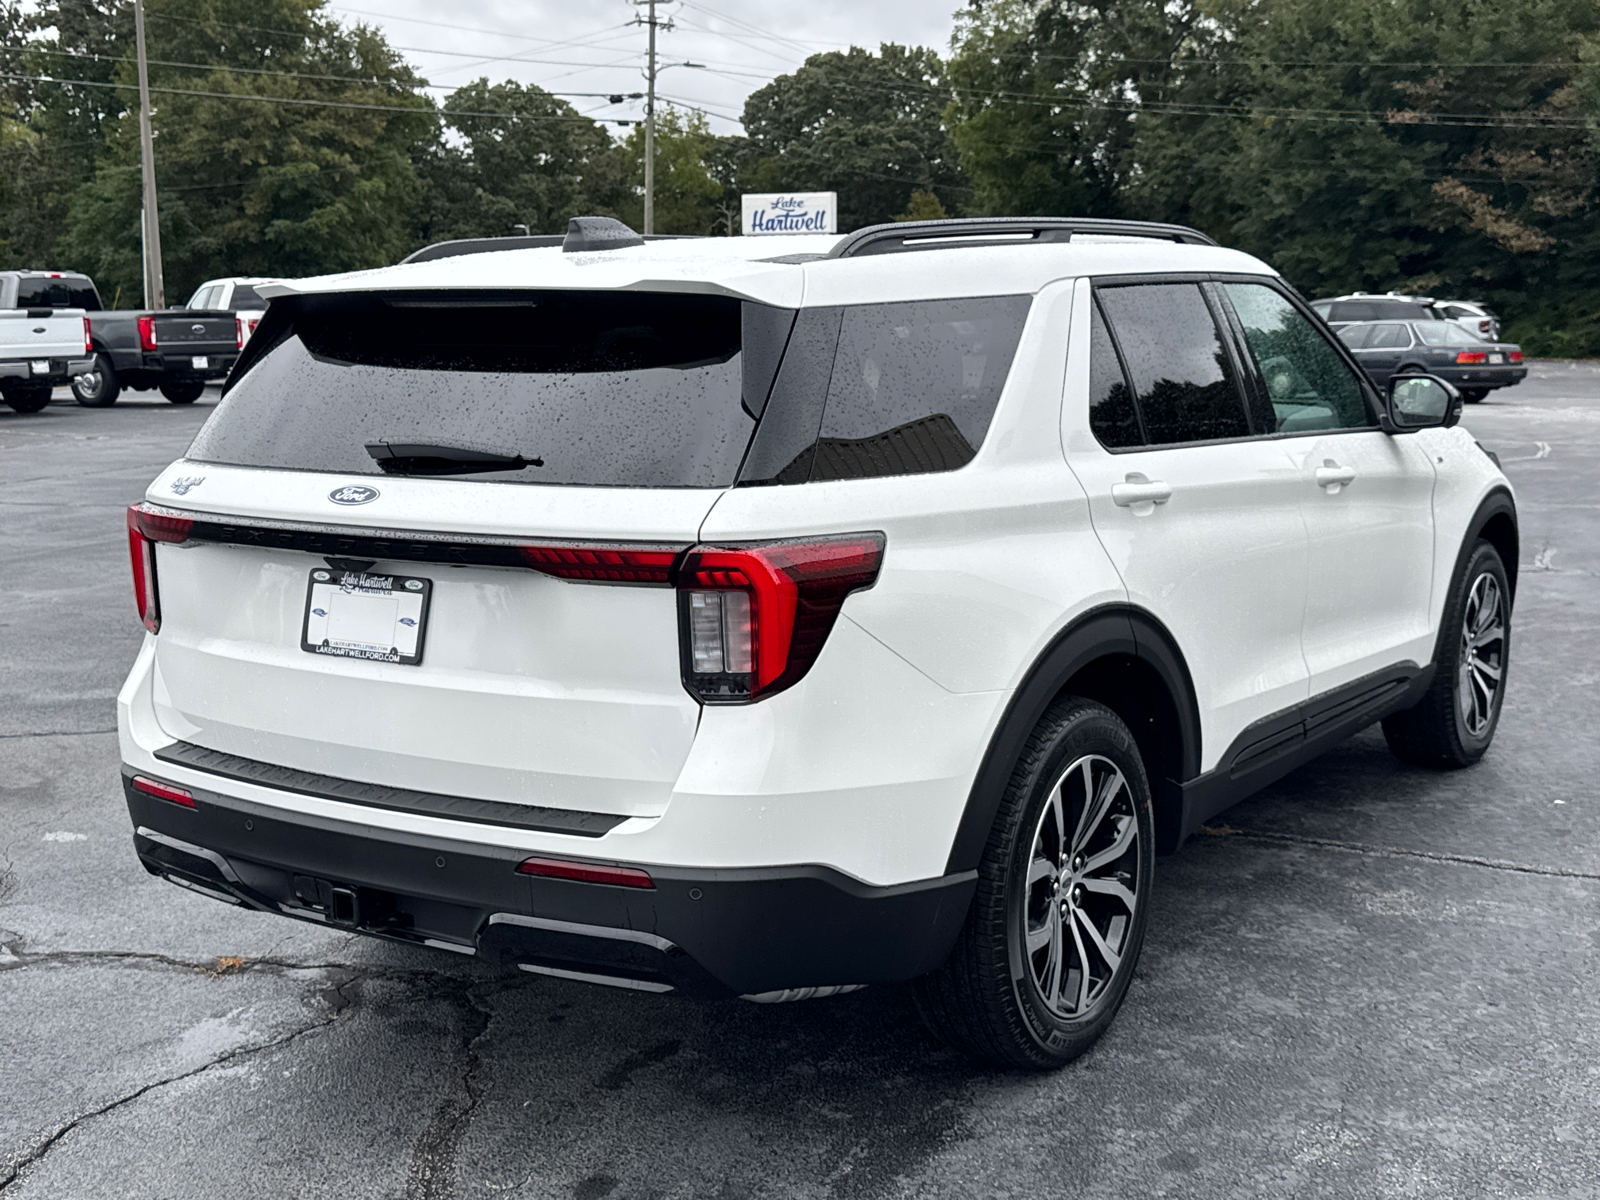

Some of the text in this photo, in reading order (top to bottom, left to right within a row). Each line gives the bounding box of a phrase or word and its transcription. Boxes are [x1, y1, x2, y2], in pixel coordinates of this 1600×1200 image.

[771, 197, 804, 212] Lake
[752, 210, 826, 232] Hartwell
[221, 527, 468, 560] EXPLORER
[341, 571, 393, 589] Lake Hartwell
[315, 645, 400, 662] LAKEHARTWELLFORD.COM
